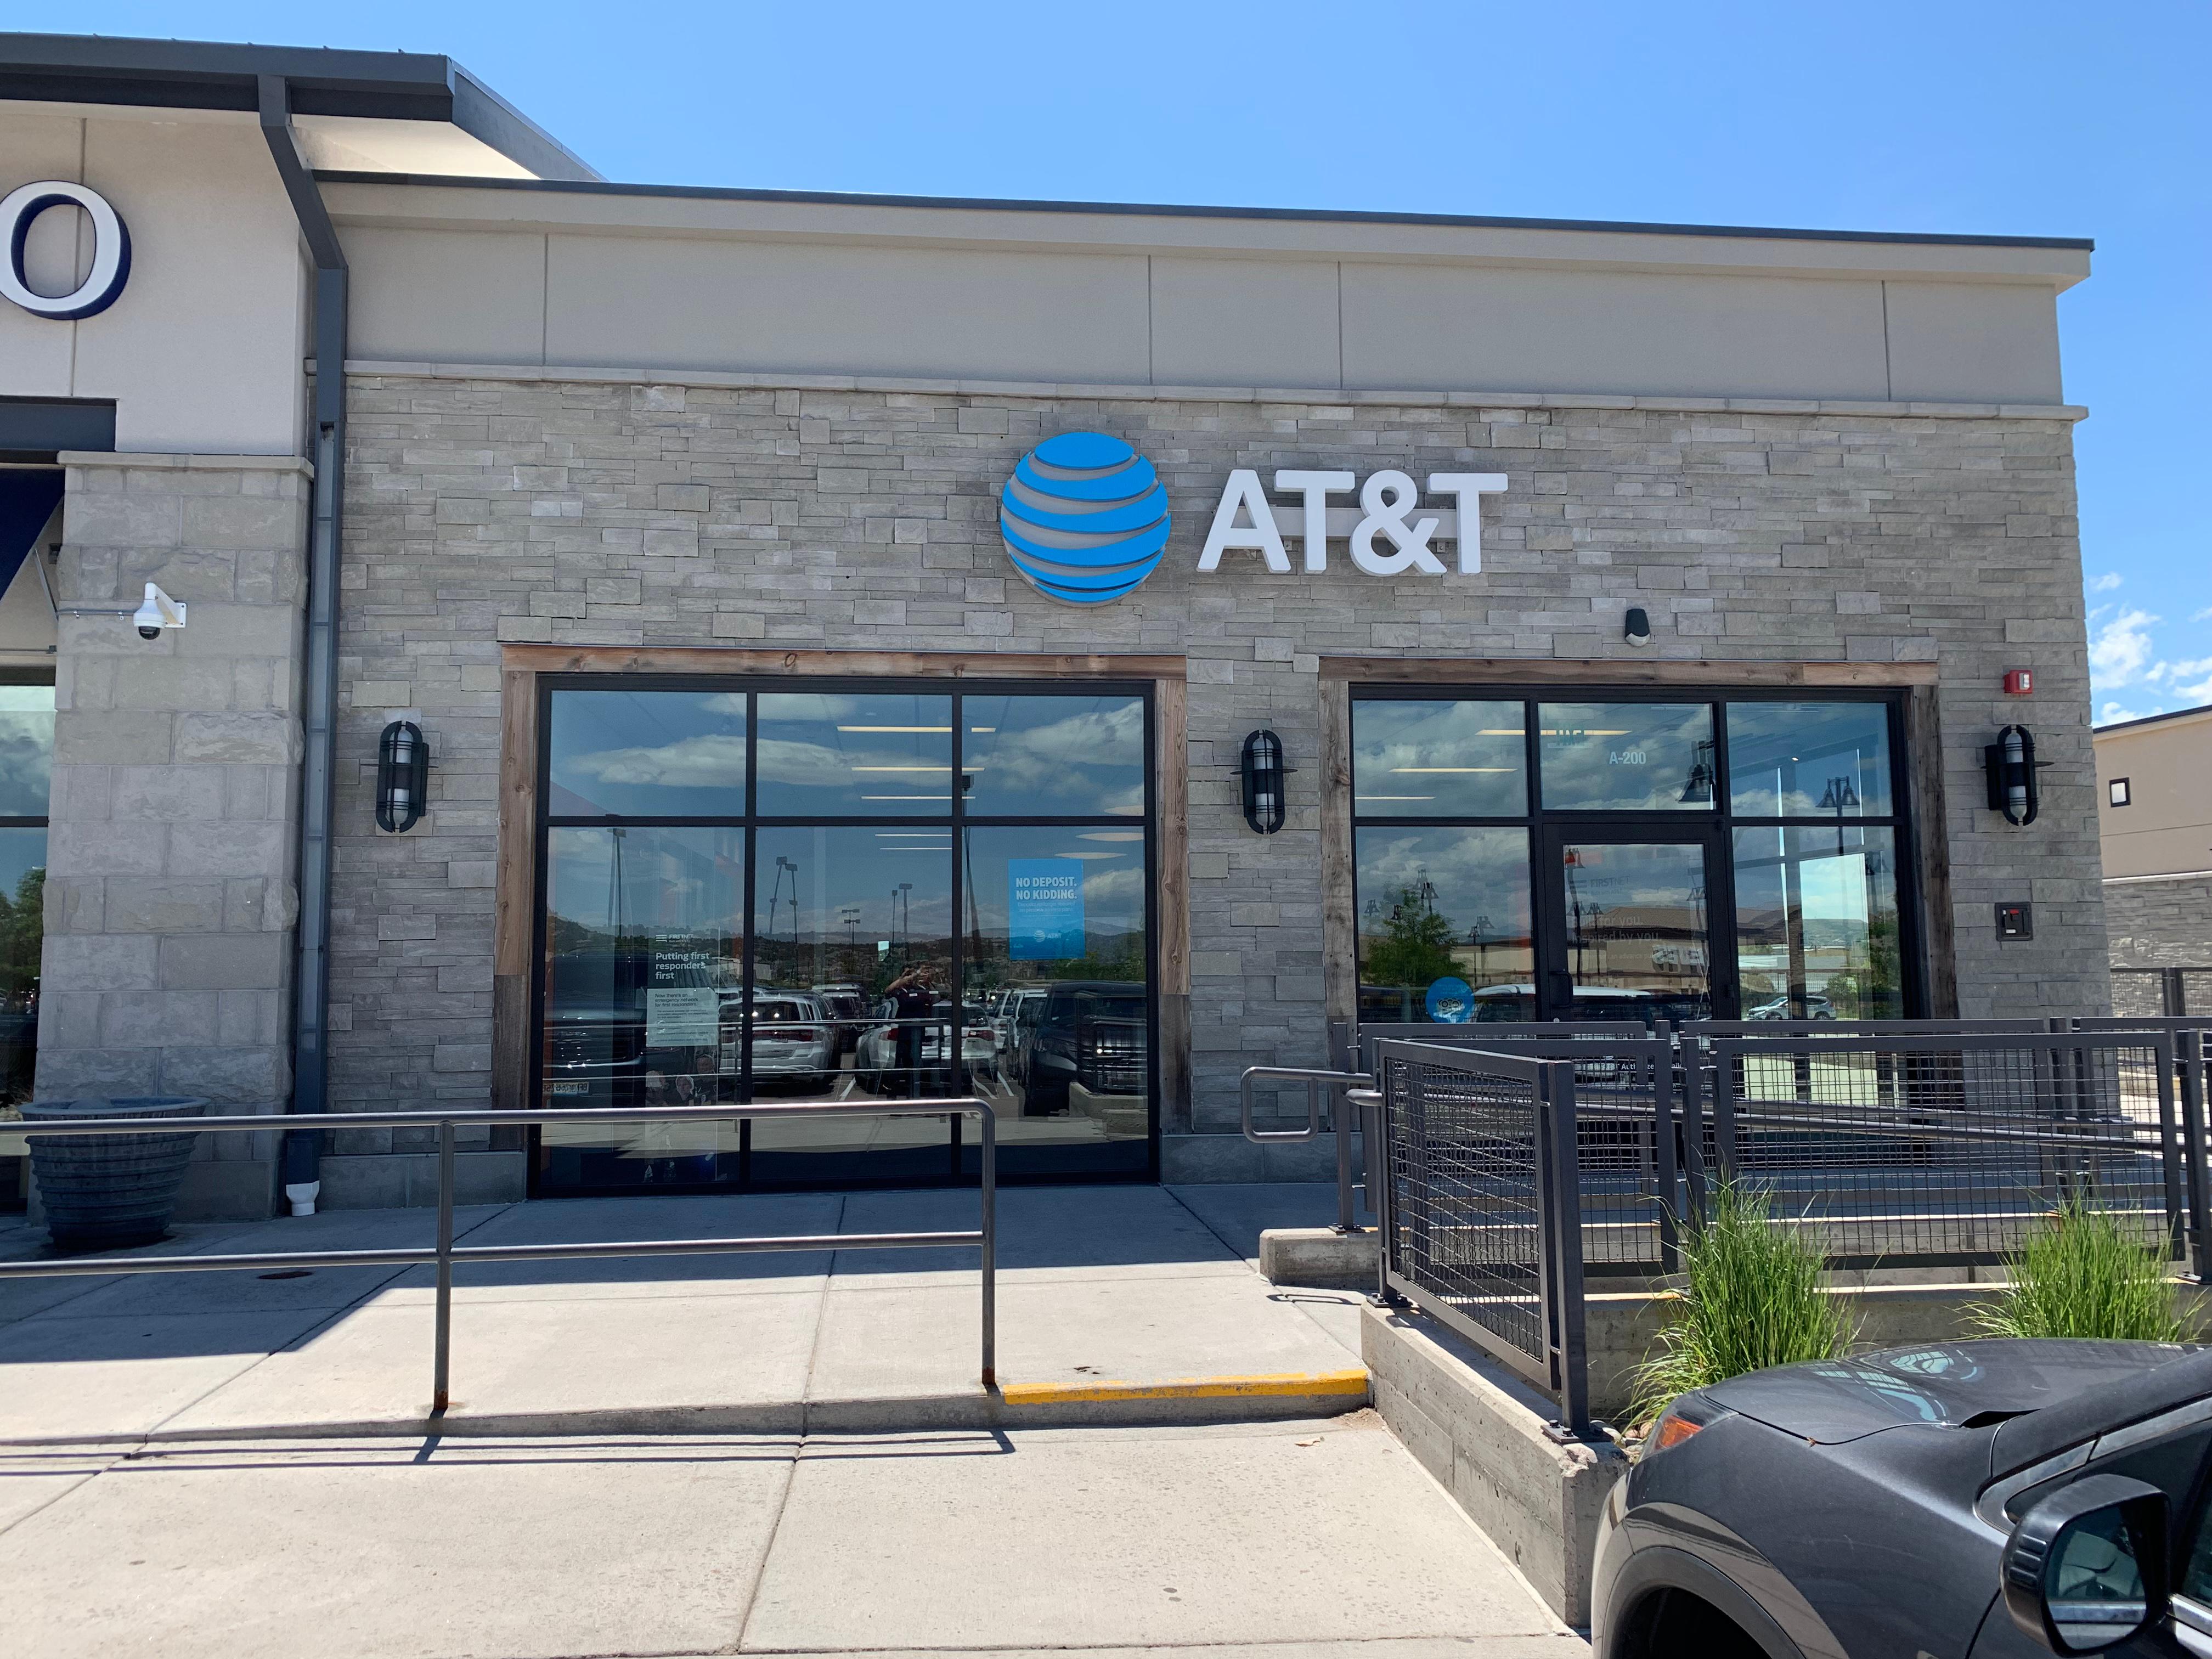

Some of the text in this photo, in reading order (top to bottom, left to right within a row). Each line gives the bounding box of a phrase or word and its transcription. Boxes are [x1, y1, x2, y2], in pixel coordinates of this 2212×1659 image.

[1196, 469, 1508, 577] AT&T
[1609, 751, 1646, 764] A-200
[1016, 877, 1077, 887] NO DEPOSIT.
[1590, 876, 1630, 887] FIRSTNET
[1017, 889, 1077, 900] NO KIDDING.
[1619, 916, 1643, 928] you.
[1619, 930, 1633, 945] by
[1637, 930, 1662, 944] you.
[656, 951, 710, 961] Putting first
[656, 962, 706, 971] responders
